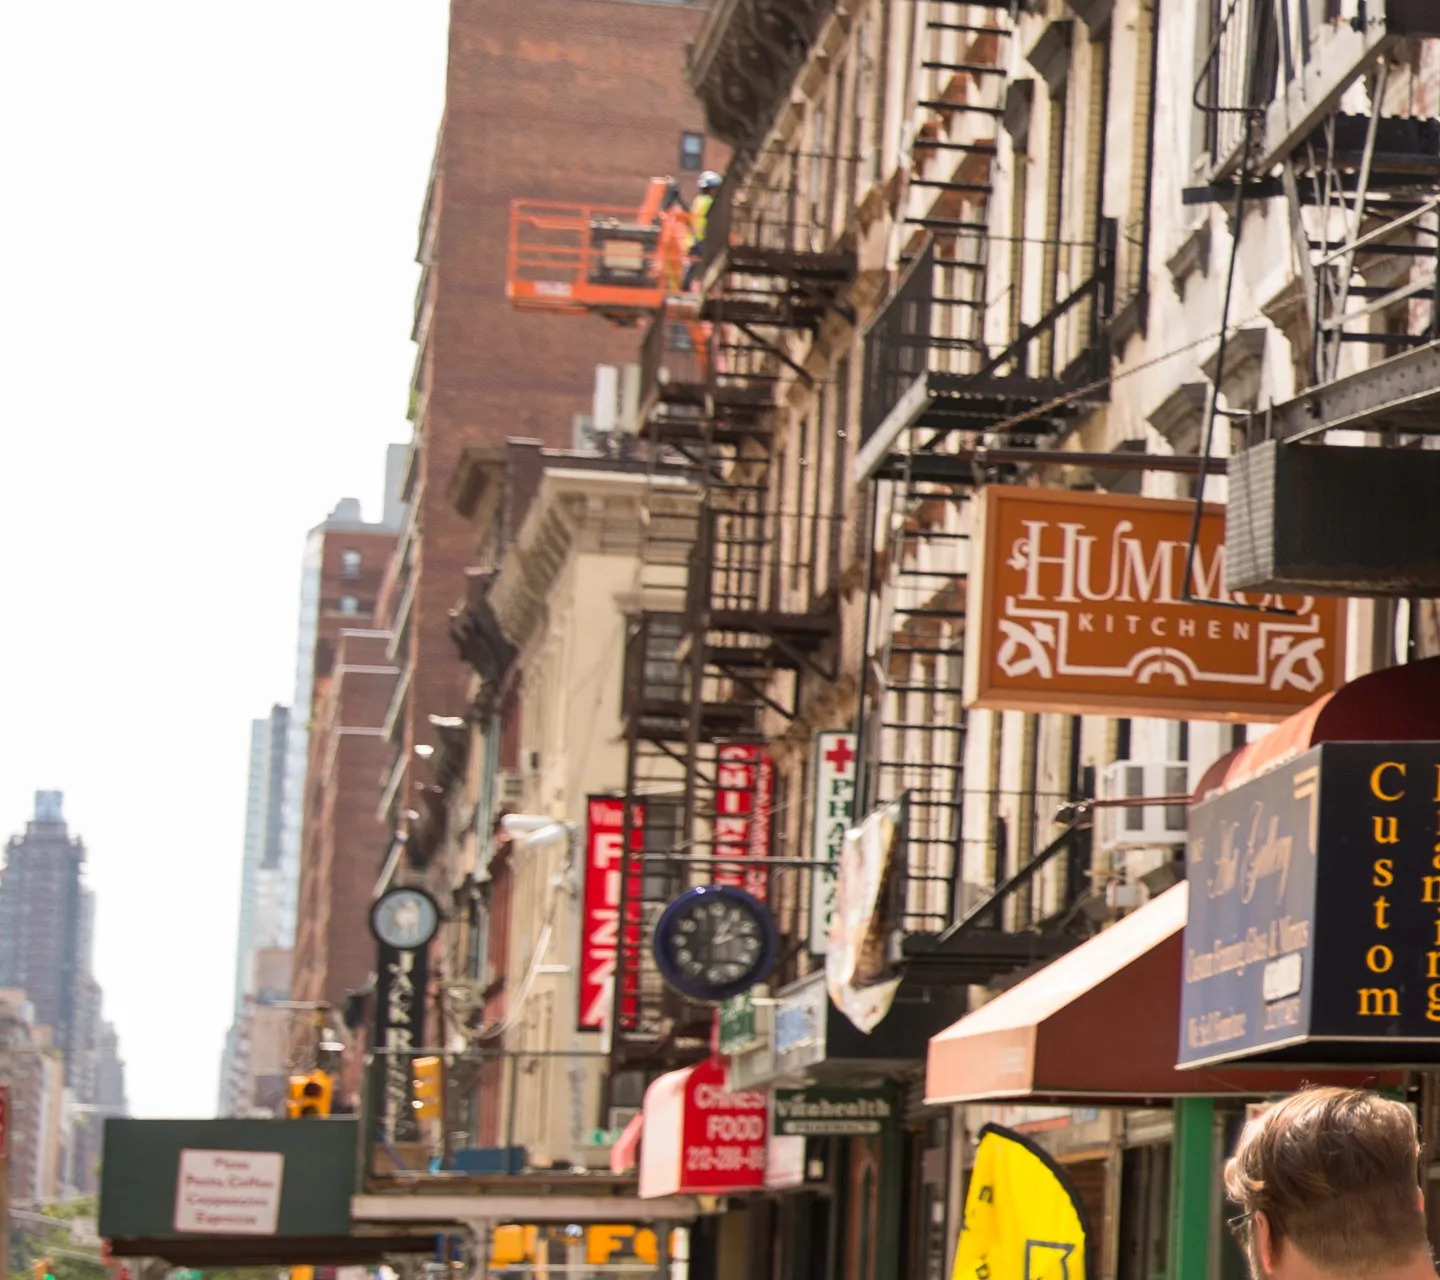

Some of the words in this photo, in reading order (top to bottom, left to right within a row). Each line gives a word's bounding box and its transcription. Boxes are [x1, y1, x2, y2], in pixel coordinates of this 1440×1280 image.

[1077, 611, 1251, 641] KITCHEN
[1356, 761, 1407, 1017] Custom
[706, 1115, 764, 1141] FOOD
